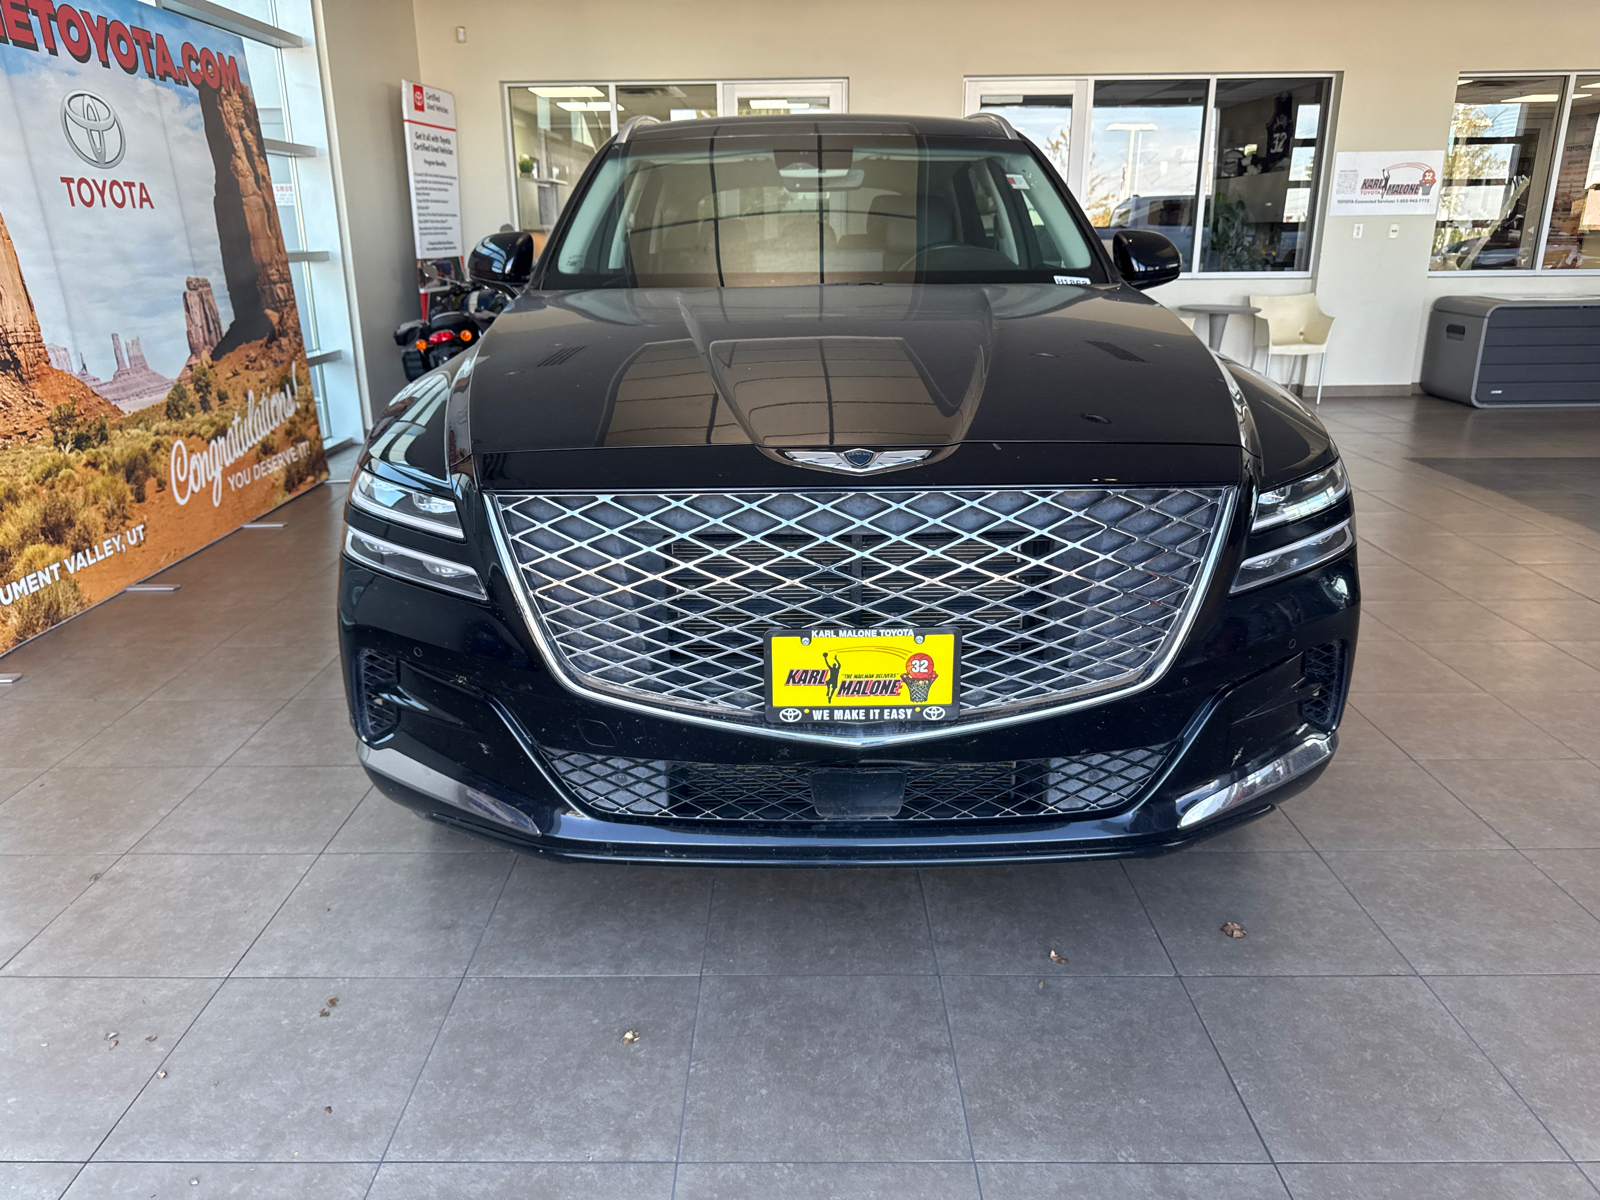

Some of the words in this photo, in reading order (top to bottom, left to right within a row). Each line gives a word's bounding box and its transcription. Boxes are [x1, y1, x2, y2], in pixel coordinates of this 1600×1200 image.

[0, 0, 242, 94] ETOYOTA.COM
[426, 92, 440, 103] Certified
[436, 105, 449, 114] Vehicles
[413, 142, 430, 152] Certified
[1270, 132, 1287, 153] 32
[1424, 172, 1433, 180] 32
[1361, 178, 1382, 189] KARL
[1386, 183, 1421, 195] MALONE
[60, 176, 154, 209] TOYOTA
[170, 361, 301, 507] Congratulations!
[227, 467, 251, 491] YOU
[253, 446, 298, 481] DESERVE
[0, 562, 60, 606] UMENT
[63, 534, 126, 575] VALLEY,
[126, 523, 145, 546] UT
[811, 630, 837, 638] KARL
[838, 629, 878, 638] MALONE
[879, 628, 915, 637] TOYOTA
[911, 659, 929, 673] 32
[785, 669, 829, 686] KARL
[836, 680, 902, 697] MALONE
[812, 710, 830, 721] WE
[834, 709, 866, 720] MAKE
[870, 709, 880, 720] IT
[883, 708, 913, 720] EASY
